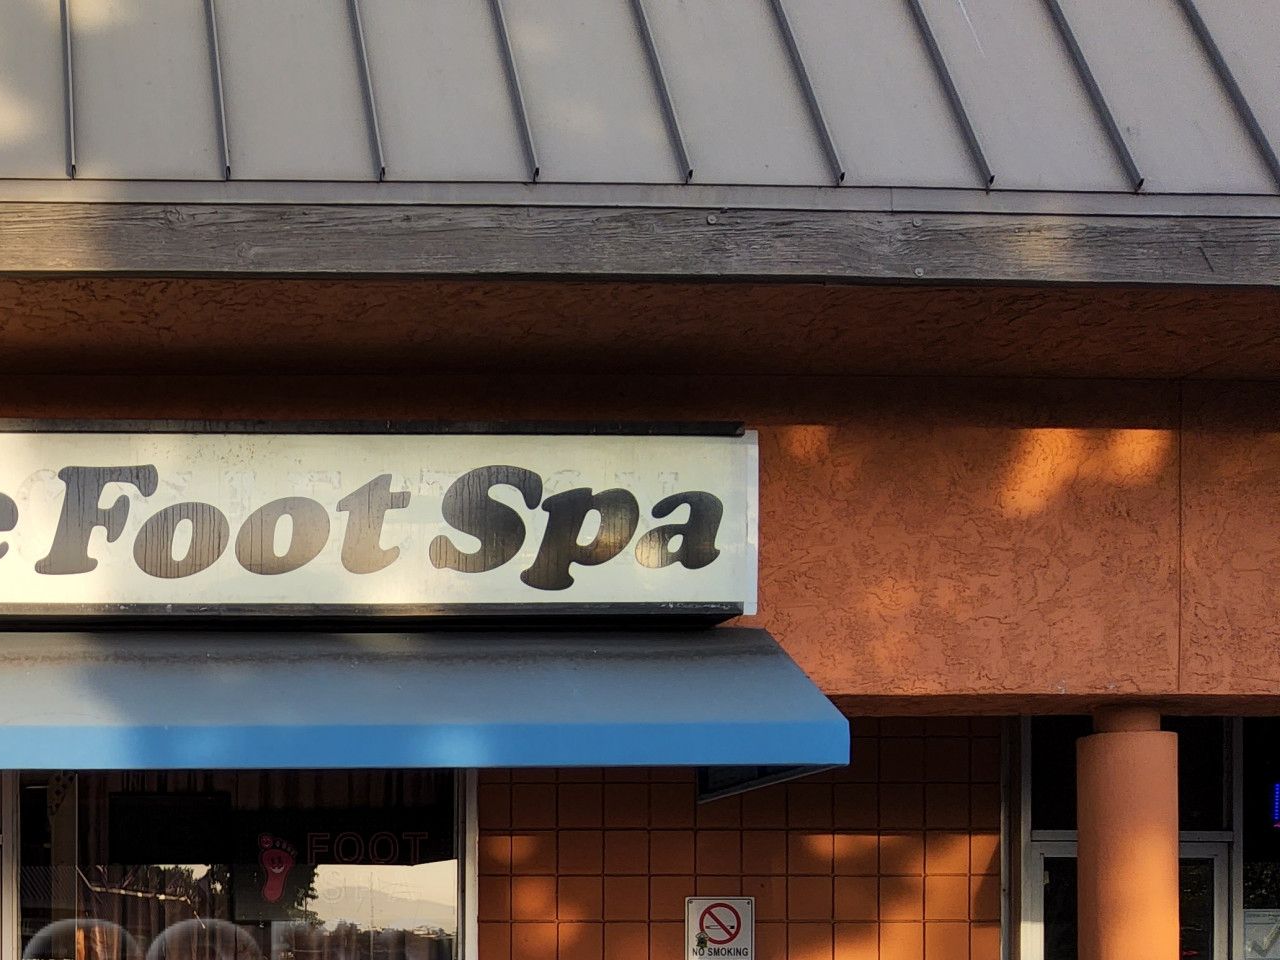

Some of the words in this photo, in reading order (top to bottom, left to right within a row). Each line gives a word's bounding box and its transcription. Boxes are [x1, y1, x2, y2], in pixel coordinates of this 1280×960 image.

[34, 463, 411, 579] Foot
[429, 465, 724, 591] Spa
[306, 831, 429, 866] FOOT
[692, 947, 705, 957] NO
[707, 947, 749, 957] SMOKING
